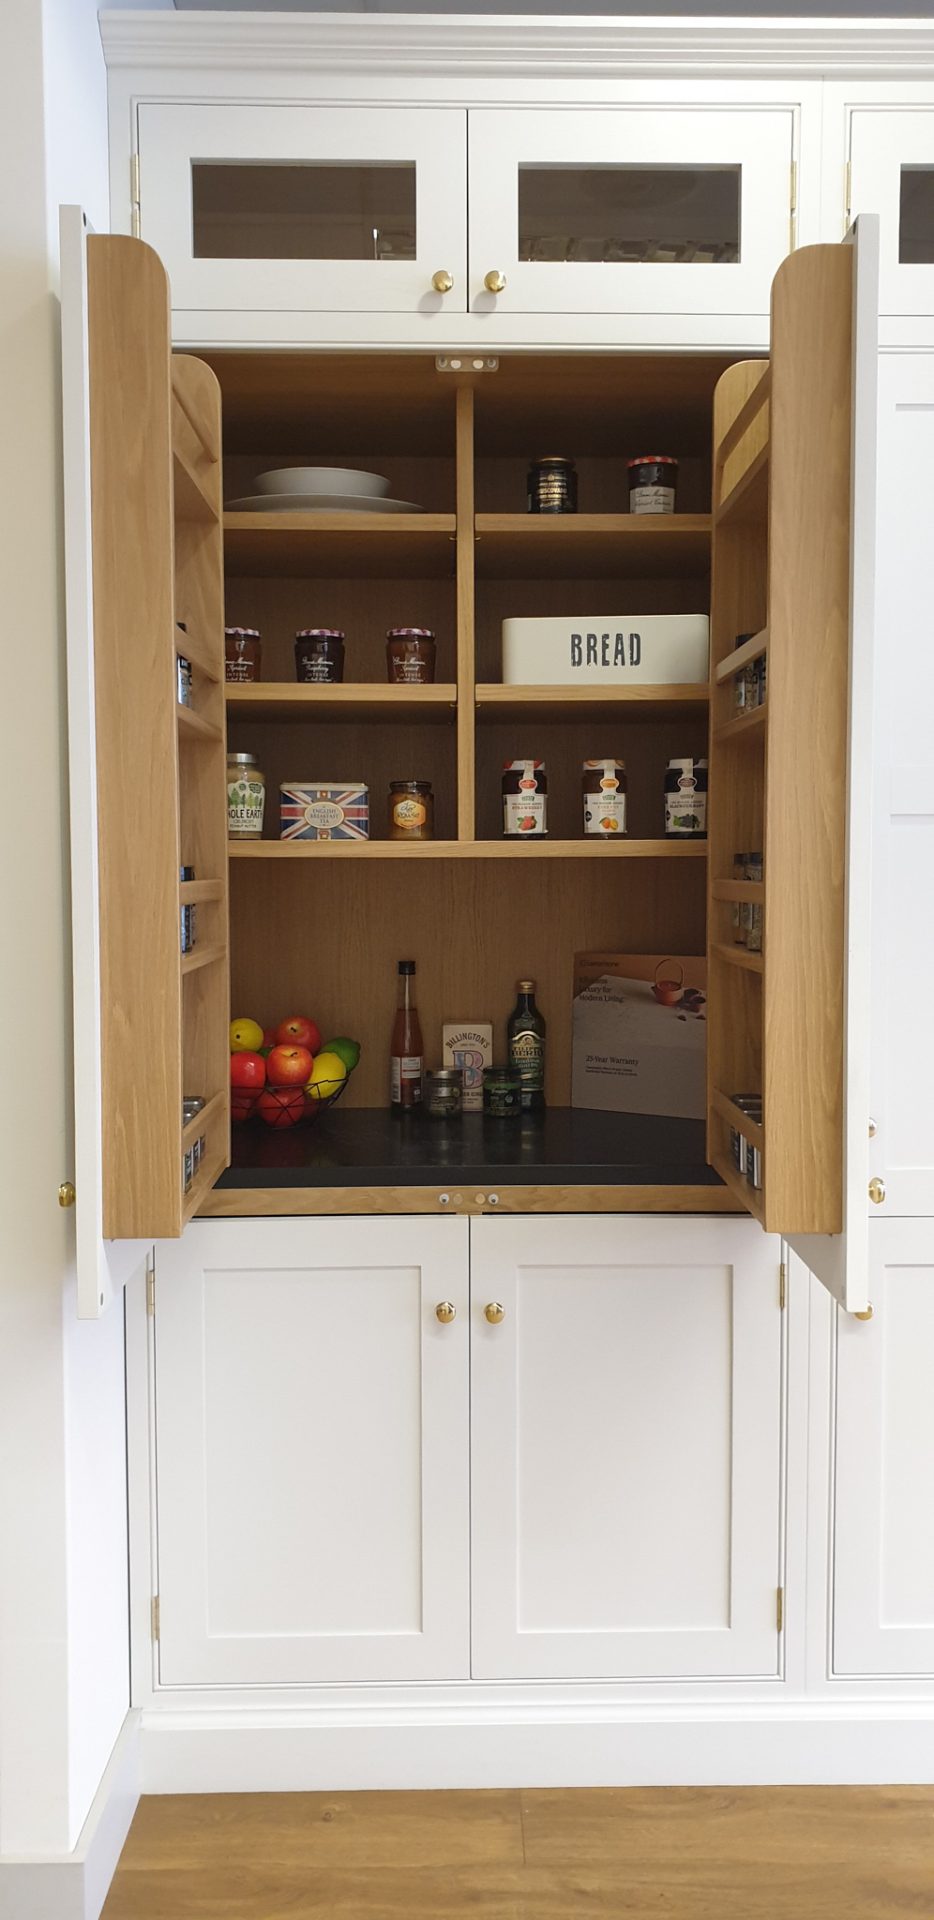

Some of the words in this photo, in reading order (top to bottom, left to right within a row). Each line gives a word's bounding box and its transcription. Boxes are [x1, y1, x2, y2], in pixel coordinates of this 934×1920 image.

[570, 633, 641, 667] BREAD
[246, 809, 263, 819] EARTH
[445, 1031, 491, 1049] BILLINGTON'S
[608, 1056, 639, 1067] Warranty
